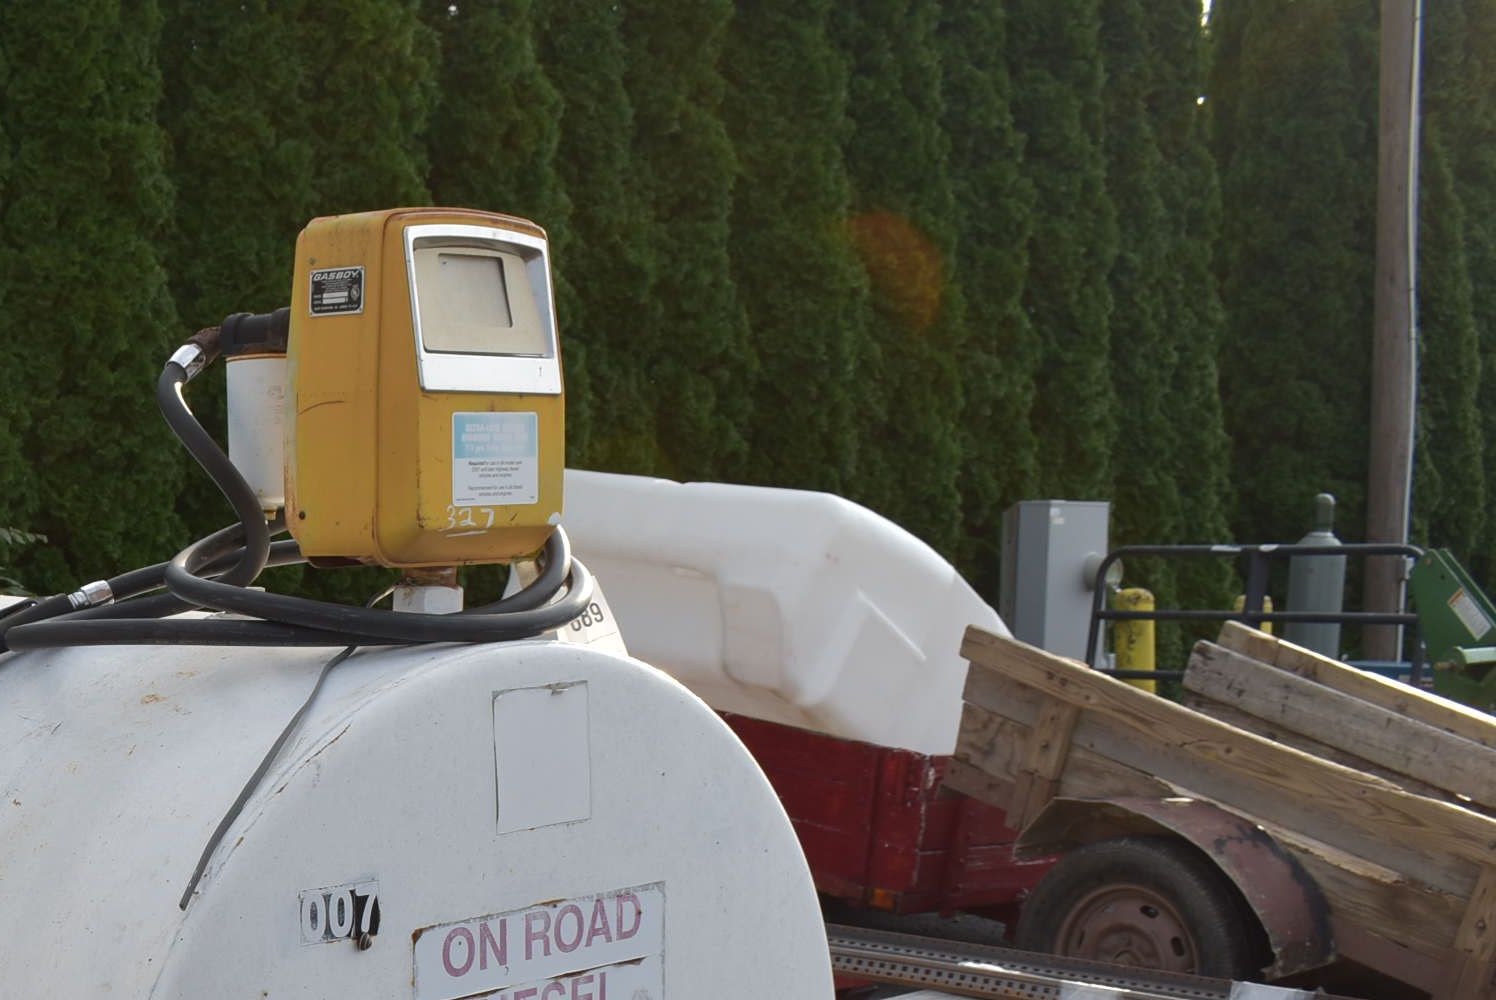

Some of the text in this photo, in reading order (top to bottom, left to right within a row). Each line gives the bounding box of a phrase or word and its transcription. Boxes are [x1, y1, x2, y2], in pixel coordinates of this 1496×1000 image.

[314, 271, 359, 281] GASBOY
[445, 505, 495, 530] 327
[301, 886, 380, 942] 007
[442, 894, 642, 977] ON ROAD
